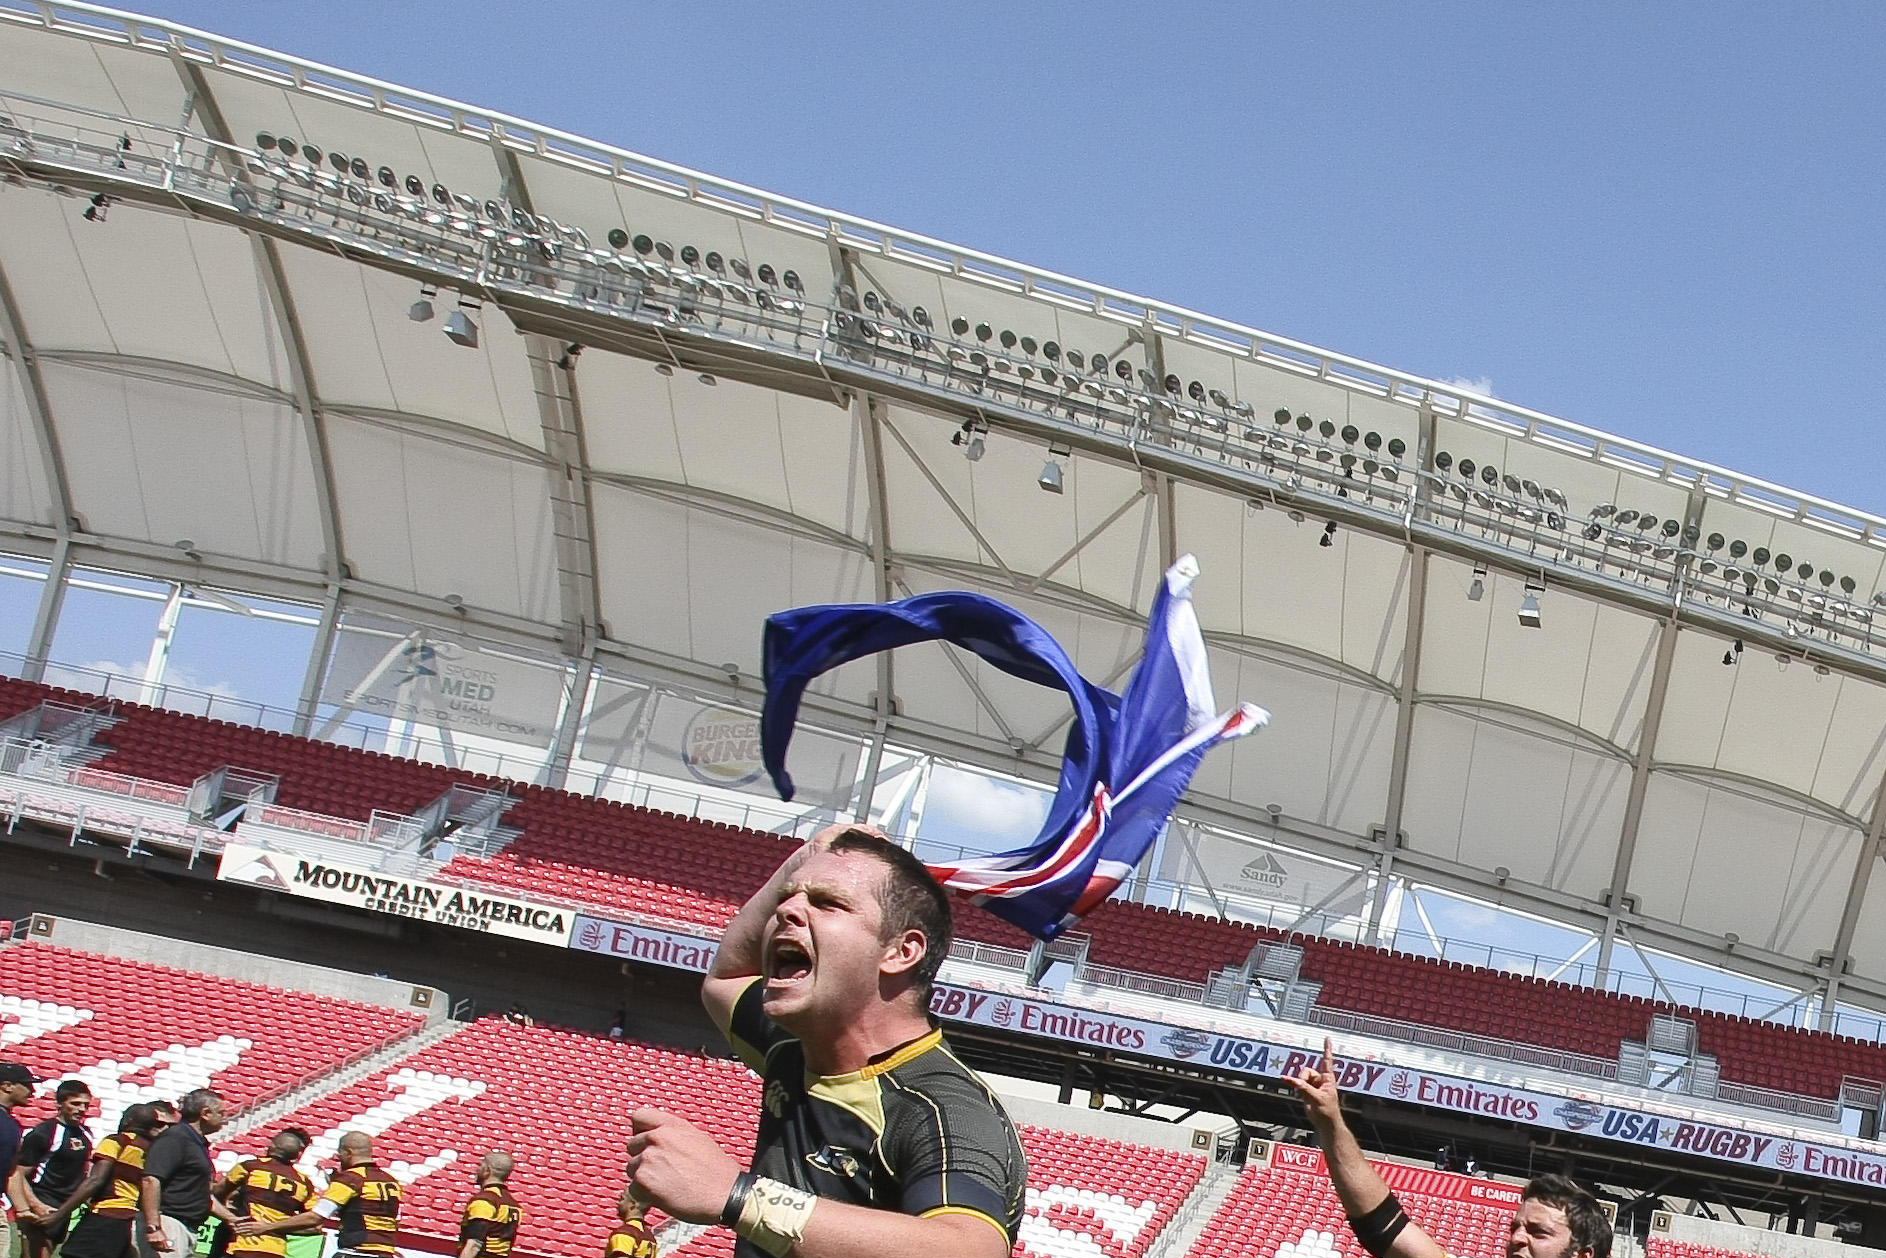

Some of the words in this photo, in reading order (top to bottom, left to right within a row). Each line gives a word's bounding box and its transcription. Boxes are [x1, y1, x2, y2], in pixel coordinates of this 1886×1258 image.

[440, 677, 496, 702] MED
[450, 699, 491, 717] UTAH
[691, 722, 759, 744] BURGE
[1240, 867, 1288, 889] Sandy
[293, 859, 443, 909] MOUNTAIN
[443, 891, 565, 935] AMERICA
[364, 897, 428, 920] CREDIT
[435, 910, 492, 932] UNION
[609, 925, 716, 971] Emirat
[928, 985, 989, 1020] GBY
[1019, 1002, 1146, 1051] Emirates
[1209, 1037, 1271, 1074] USA
[1417, 1075, 1539, 1122] Emirates
[1601, 1109, 1661, 1144] USA
[1670, 1122, 1773, 1163] RUGBY
[1279, 1148, 1318, 1168] WCF
[1470, 1184, 1486, 1198] BE
[1486, 1188, 1523, 1204] CAREF
